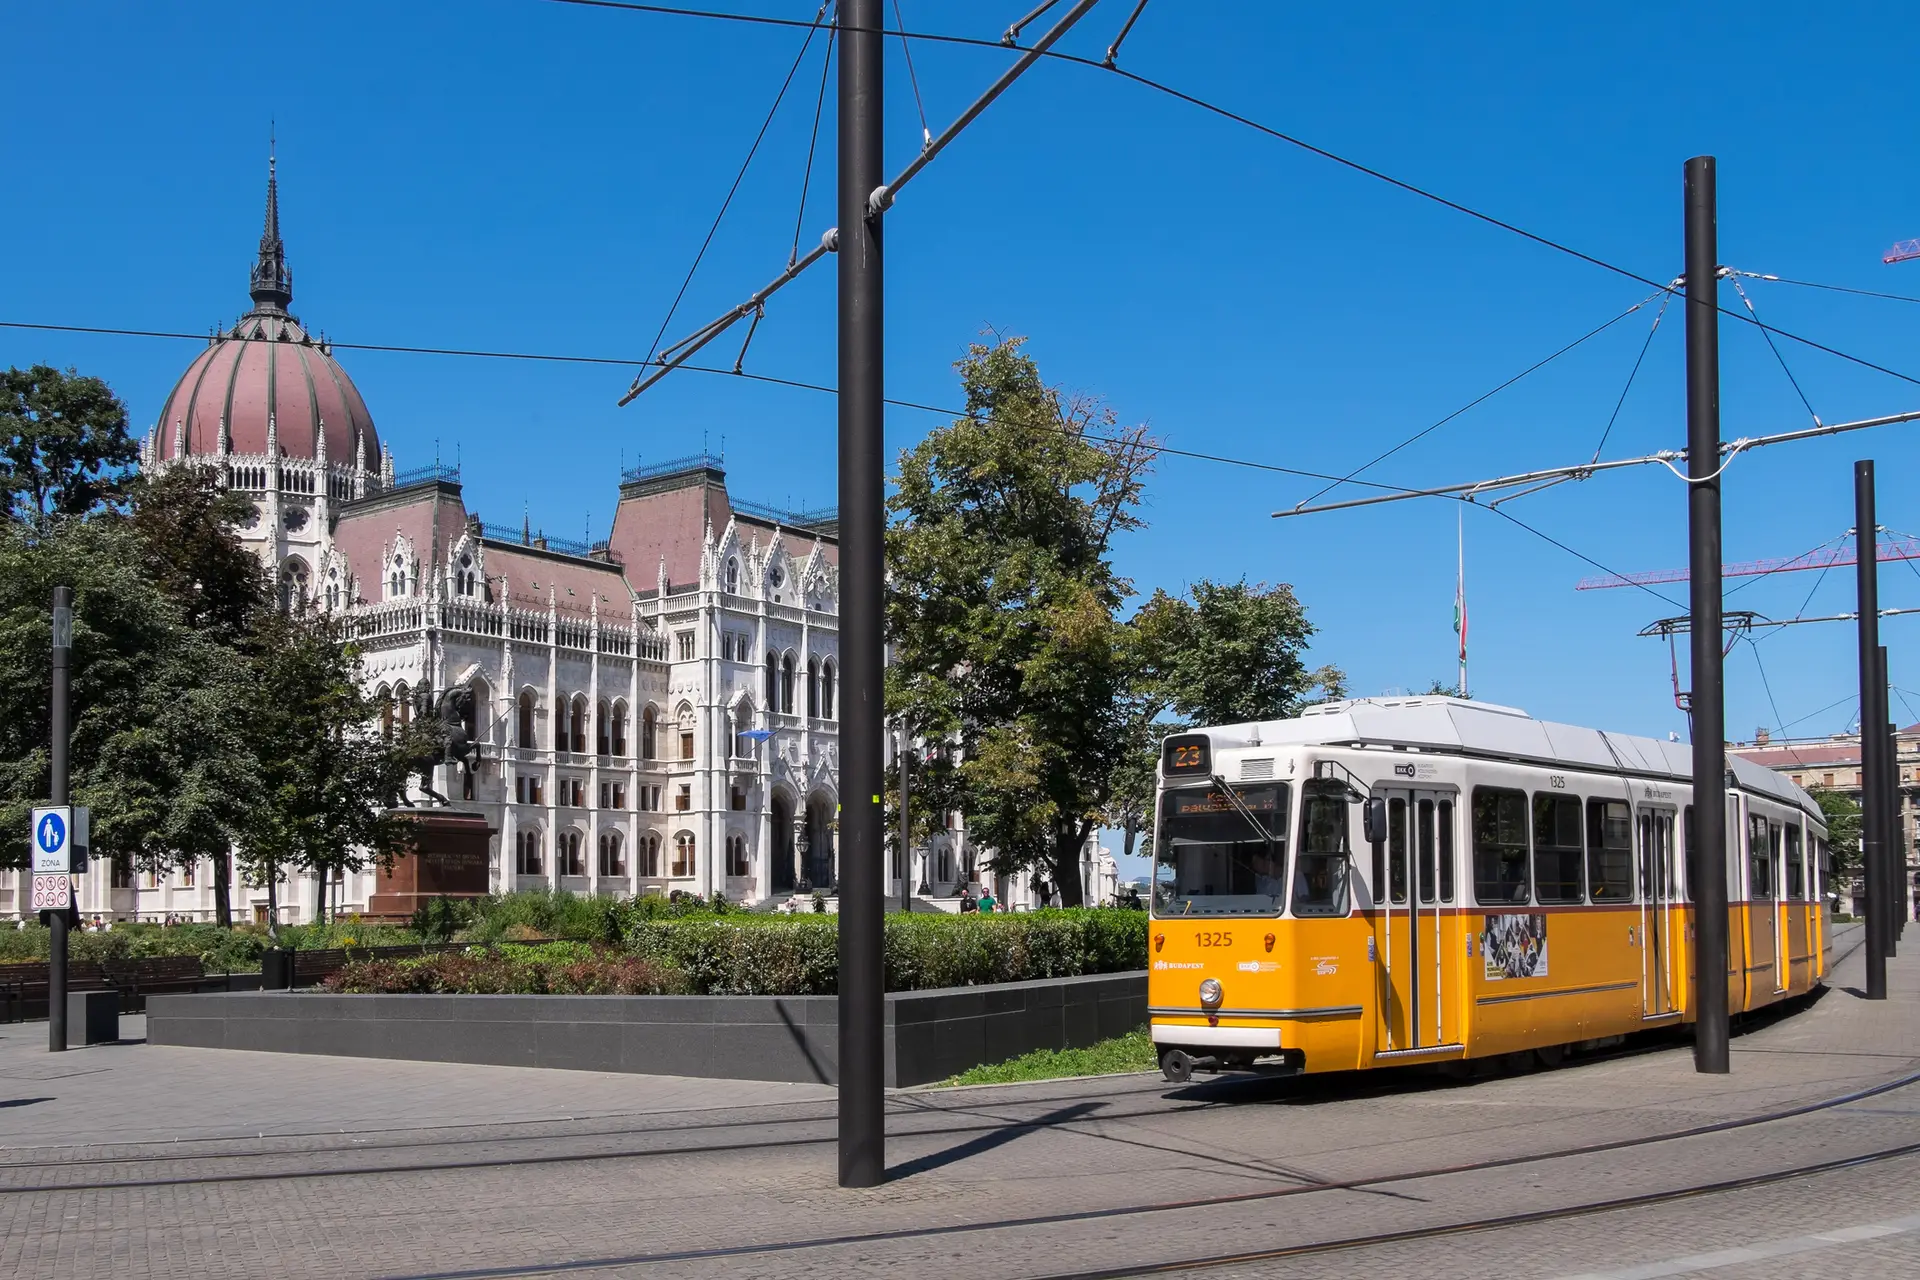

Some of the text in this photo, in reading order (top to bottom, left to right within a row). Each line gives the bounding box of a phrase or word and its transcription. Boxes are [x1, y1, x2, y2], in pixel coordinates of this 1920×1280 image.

[1176, 746, 1200, 767] 23
[1550, 776, 1565, 788] 1325
[41, 859, 60, 867] ZÓNA
[1195, 932, 1232, 947] 1325
